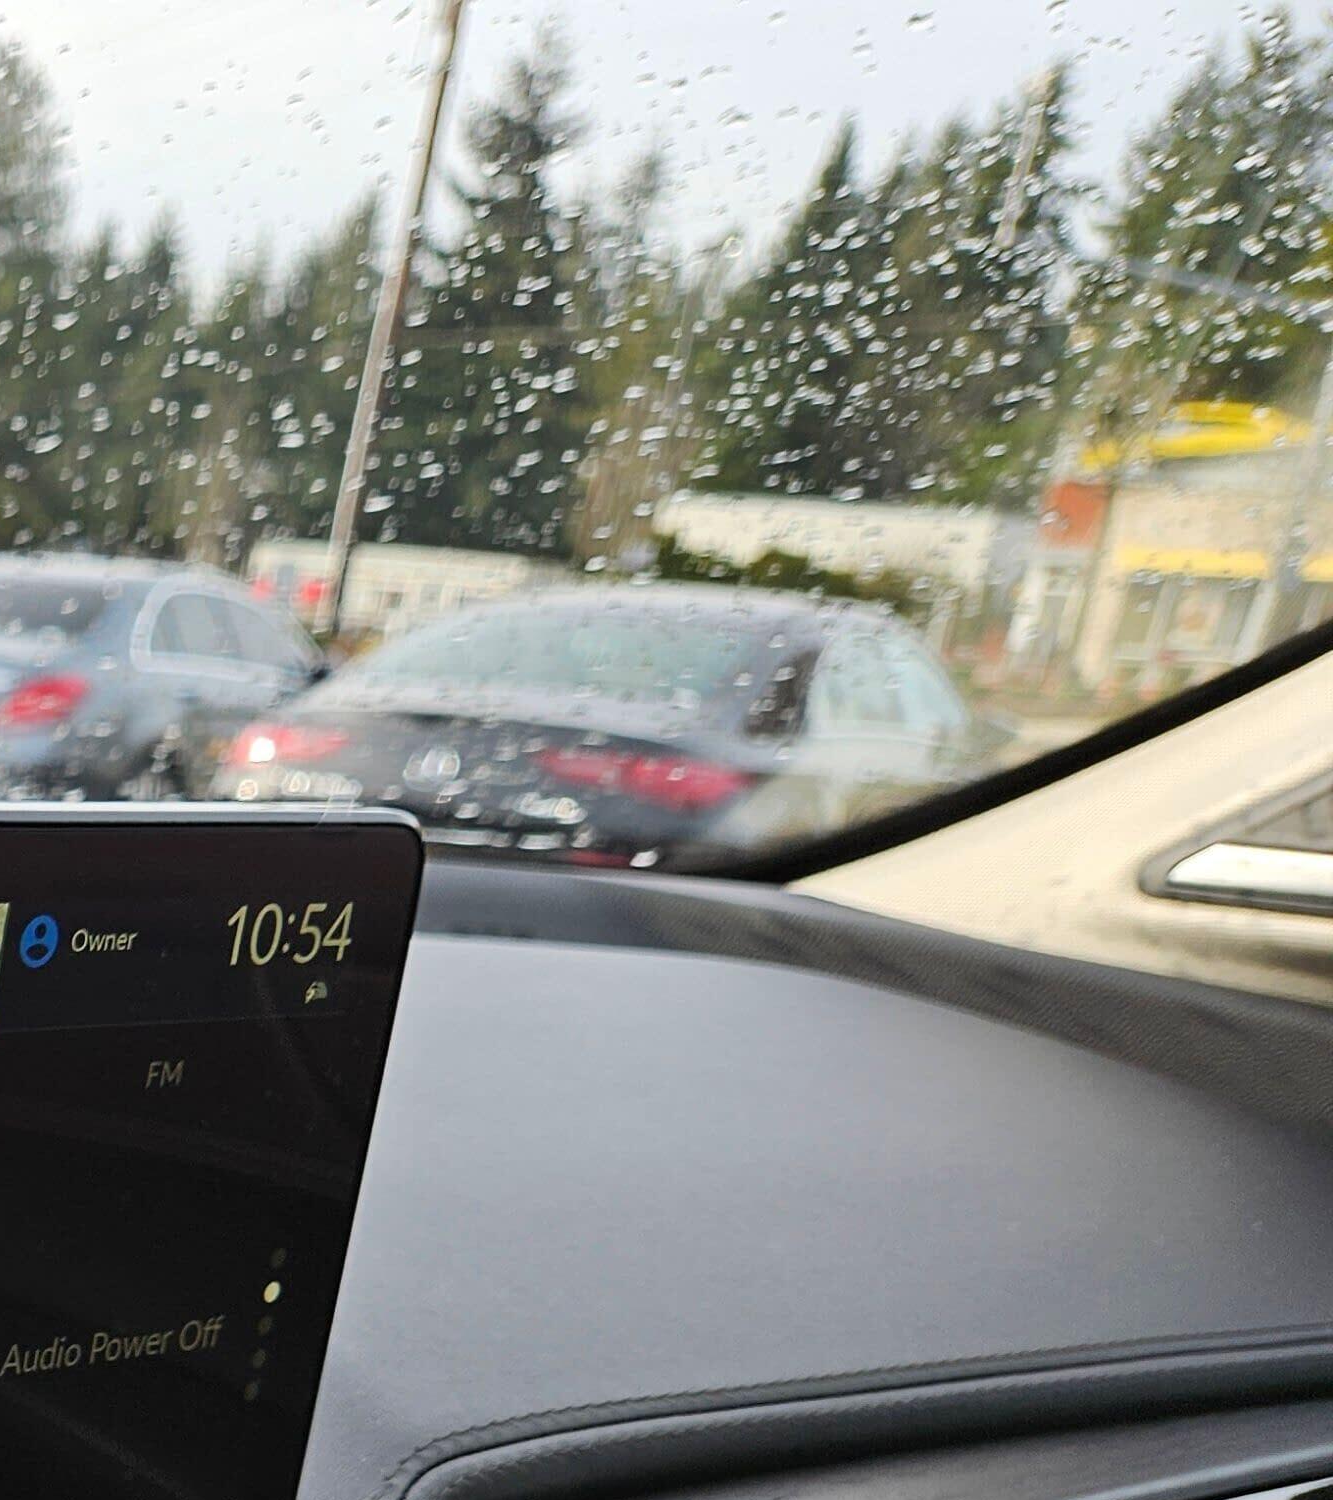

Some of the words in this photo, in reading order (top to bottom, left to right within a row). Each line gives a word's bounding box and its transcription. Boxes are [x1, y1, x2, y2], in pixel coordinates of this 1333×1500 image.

[71, 928, 138, 953] Owner
[227, 901, 355, 967] 10:54
[146, 1060, 186, 1089] FM
[0, 1336, 81, 1377] Audio
[89, 1328, 173, 1362] Power
[179, 1315, 226, 1352] Off
